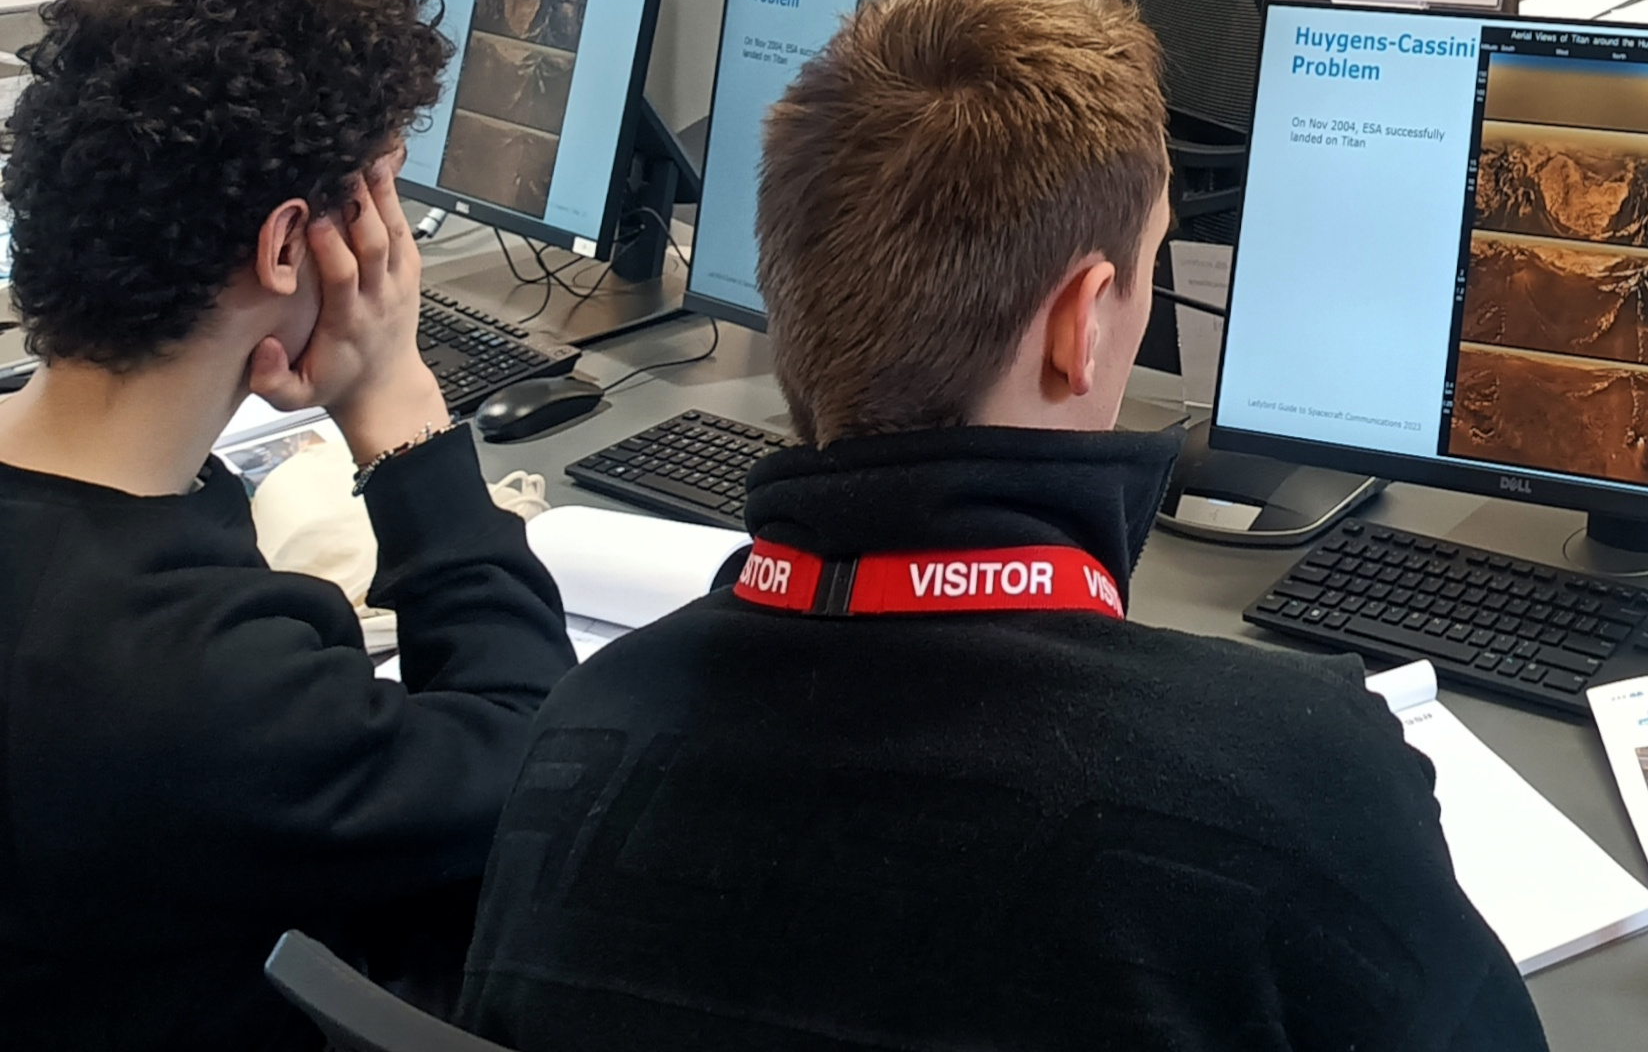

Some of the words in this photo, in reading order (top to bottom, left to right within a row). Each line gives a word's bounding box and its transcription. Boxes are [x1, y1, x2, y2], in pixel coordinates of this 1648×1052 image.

[1295, 26, 1476, 58] Huygens-Cassini
[1511, 29, 1532, 41] Aerial
[1535, 32, 1557, 43] Views
[1560, 33, 1567, 43] of
[1572, 33, 1590, 45] Titan
[1593, 36, 1619, 47] around
[1622, 37, 1635, 48] the
[1292, 55, 1380, 80] Problem
[1290, 131, 1322, 145] landed
[1325, 135, 1338, 146] on
[1342, 135, 1366, 148] Titan
[1292, 117, 1306, 128] On
[1309, 118, 1328, 130] Nov
[1331, 119, 1359, 134] 2004,
[1362, 122, 1382, 135] ESA
[1385, 125, 1446, 143] successfully
[1248, 398, 1276, 410] Ladybird
[1278, 403, 1298, 413] Guide
[1299, 406, 1306, 414] to
[1308, 406, 1344, 420] Spacecraft
[1345, 413, 1402, 429] Communications
[1500, 476, 1531, 493] DELL
[910, 561, 1054, 597] VISITOR
